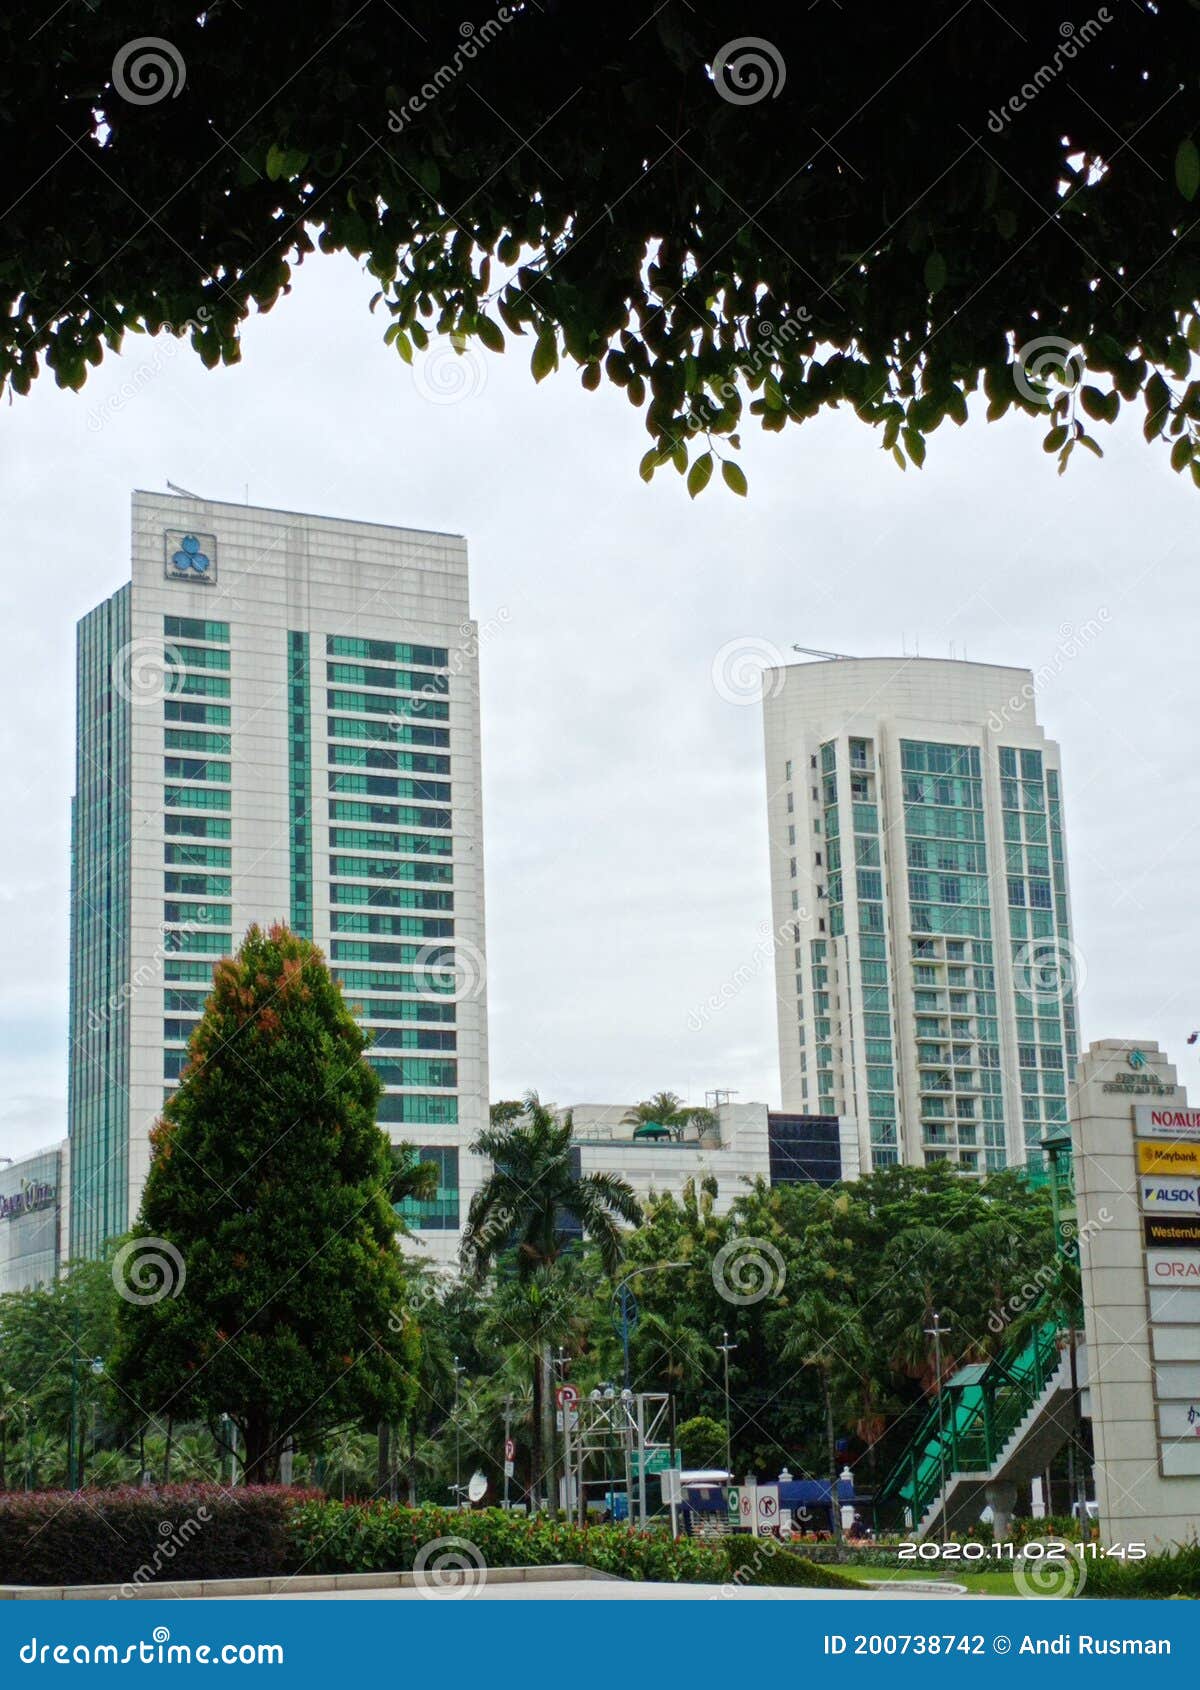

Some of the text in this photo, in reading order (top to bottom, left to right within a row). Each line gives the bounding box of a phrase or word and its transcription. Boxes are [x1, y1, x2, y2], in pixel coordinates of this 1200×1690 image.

[1154, 1150, 1197, 1163] Maybank
[1156, 1188, 1196, 1202] ALSOK
[1154, 1261, 1200, 1277] ORA
